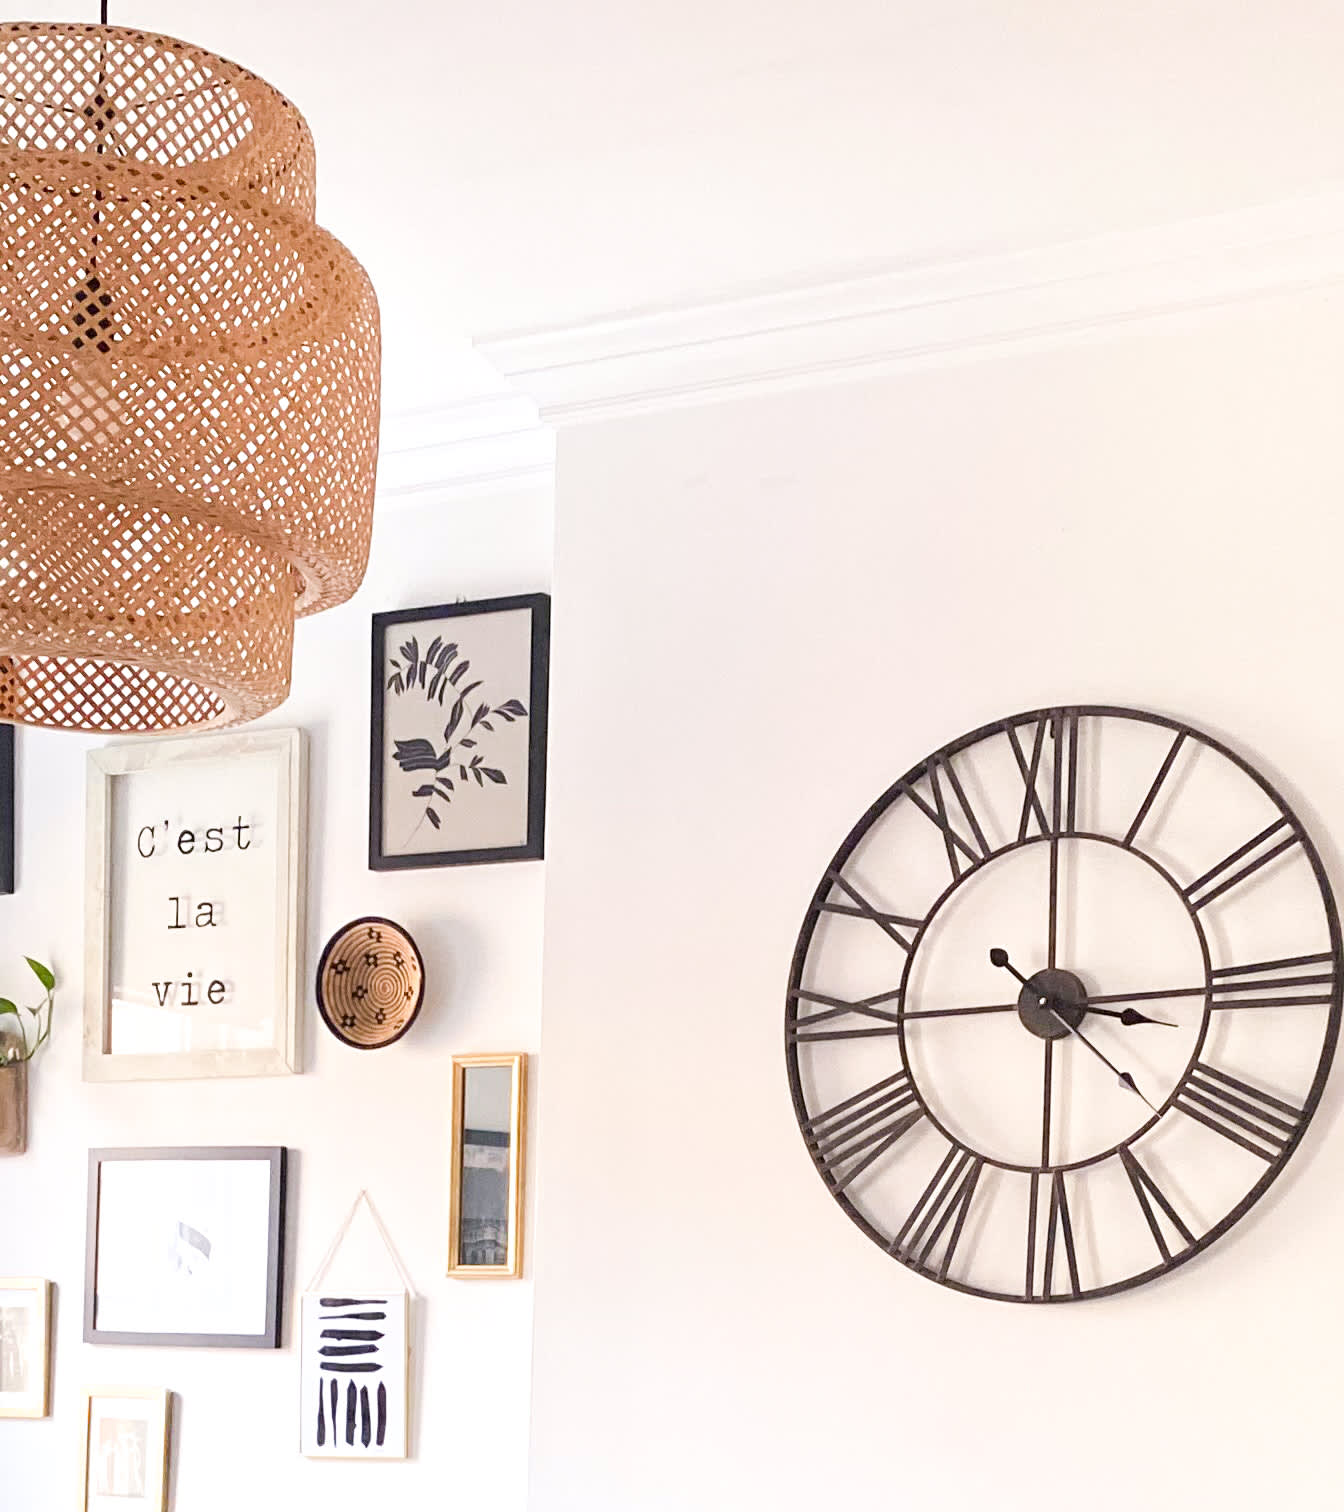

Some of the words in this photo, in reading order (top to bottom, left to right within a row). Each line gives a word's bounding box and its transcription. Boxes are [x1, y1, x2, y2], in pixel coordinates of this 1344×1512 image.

[137, 815, 251, 859] C'est
[167, 896, 217, 929] la
[152, 972, 226, 1007] vie
